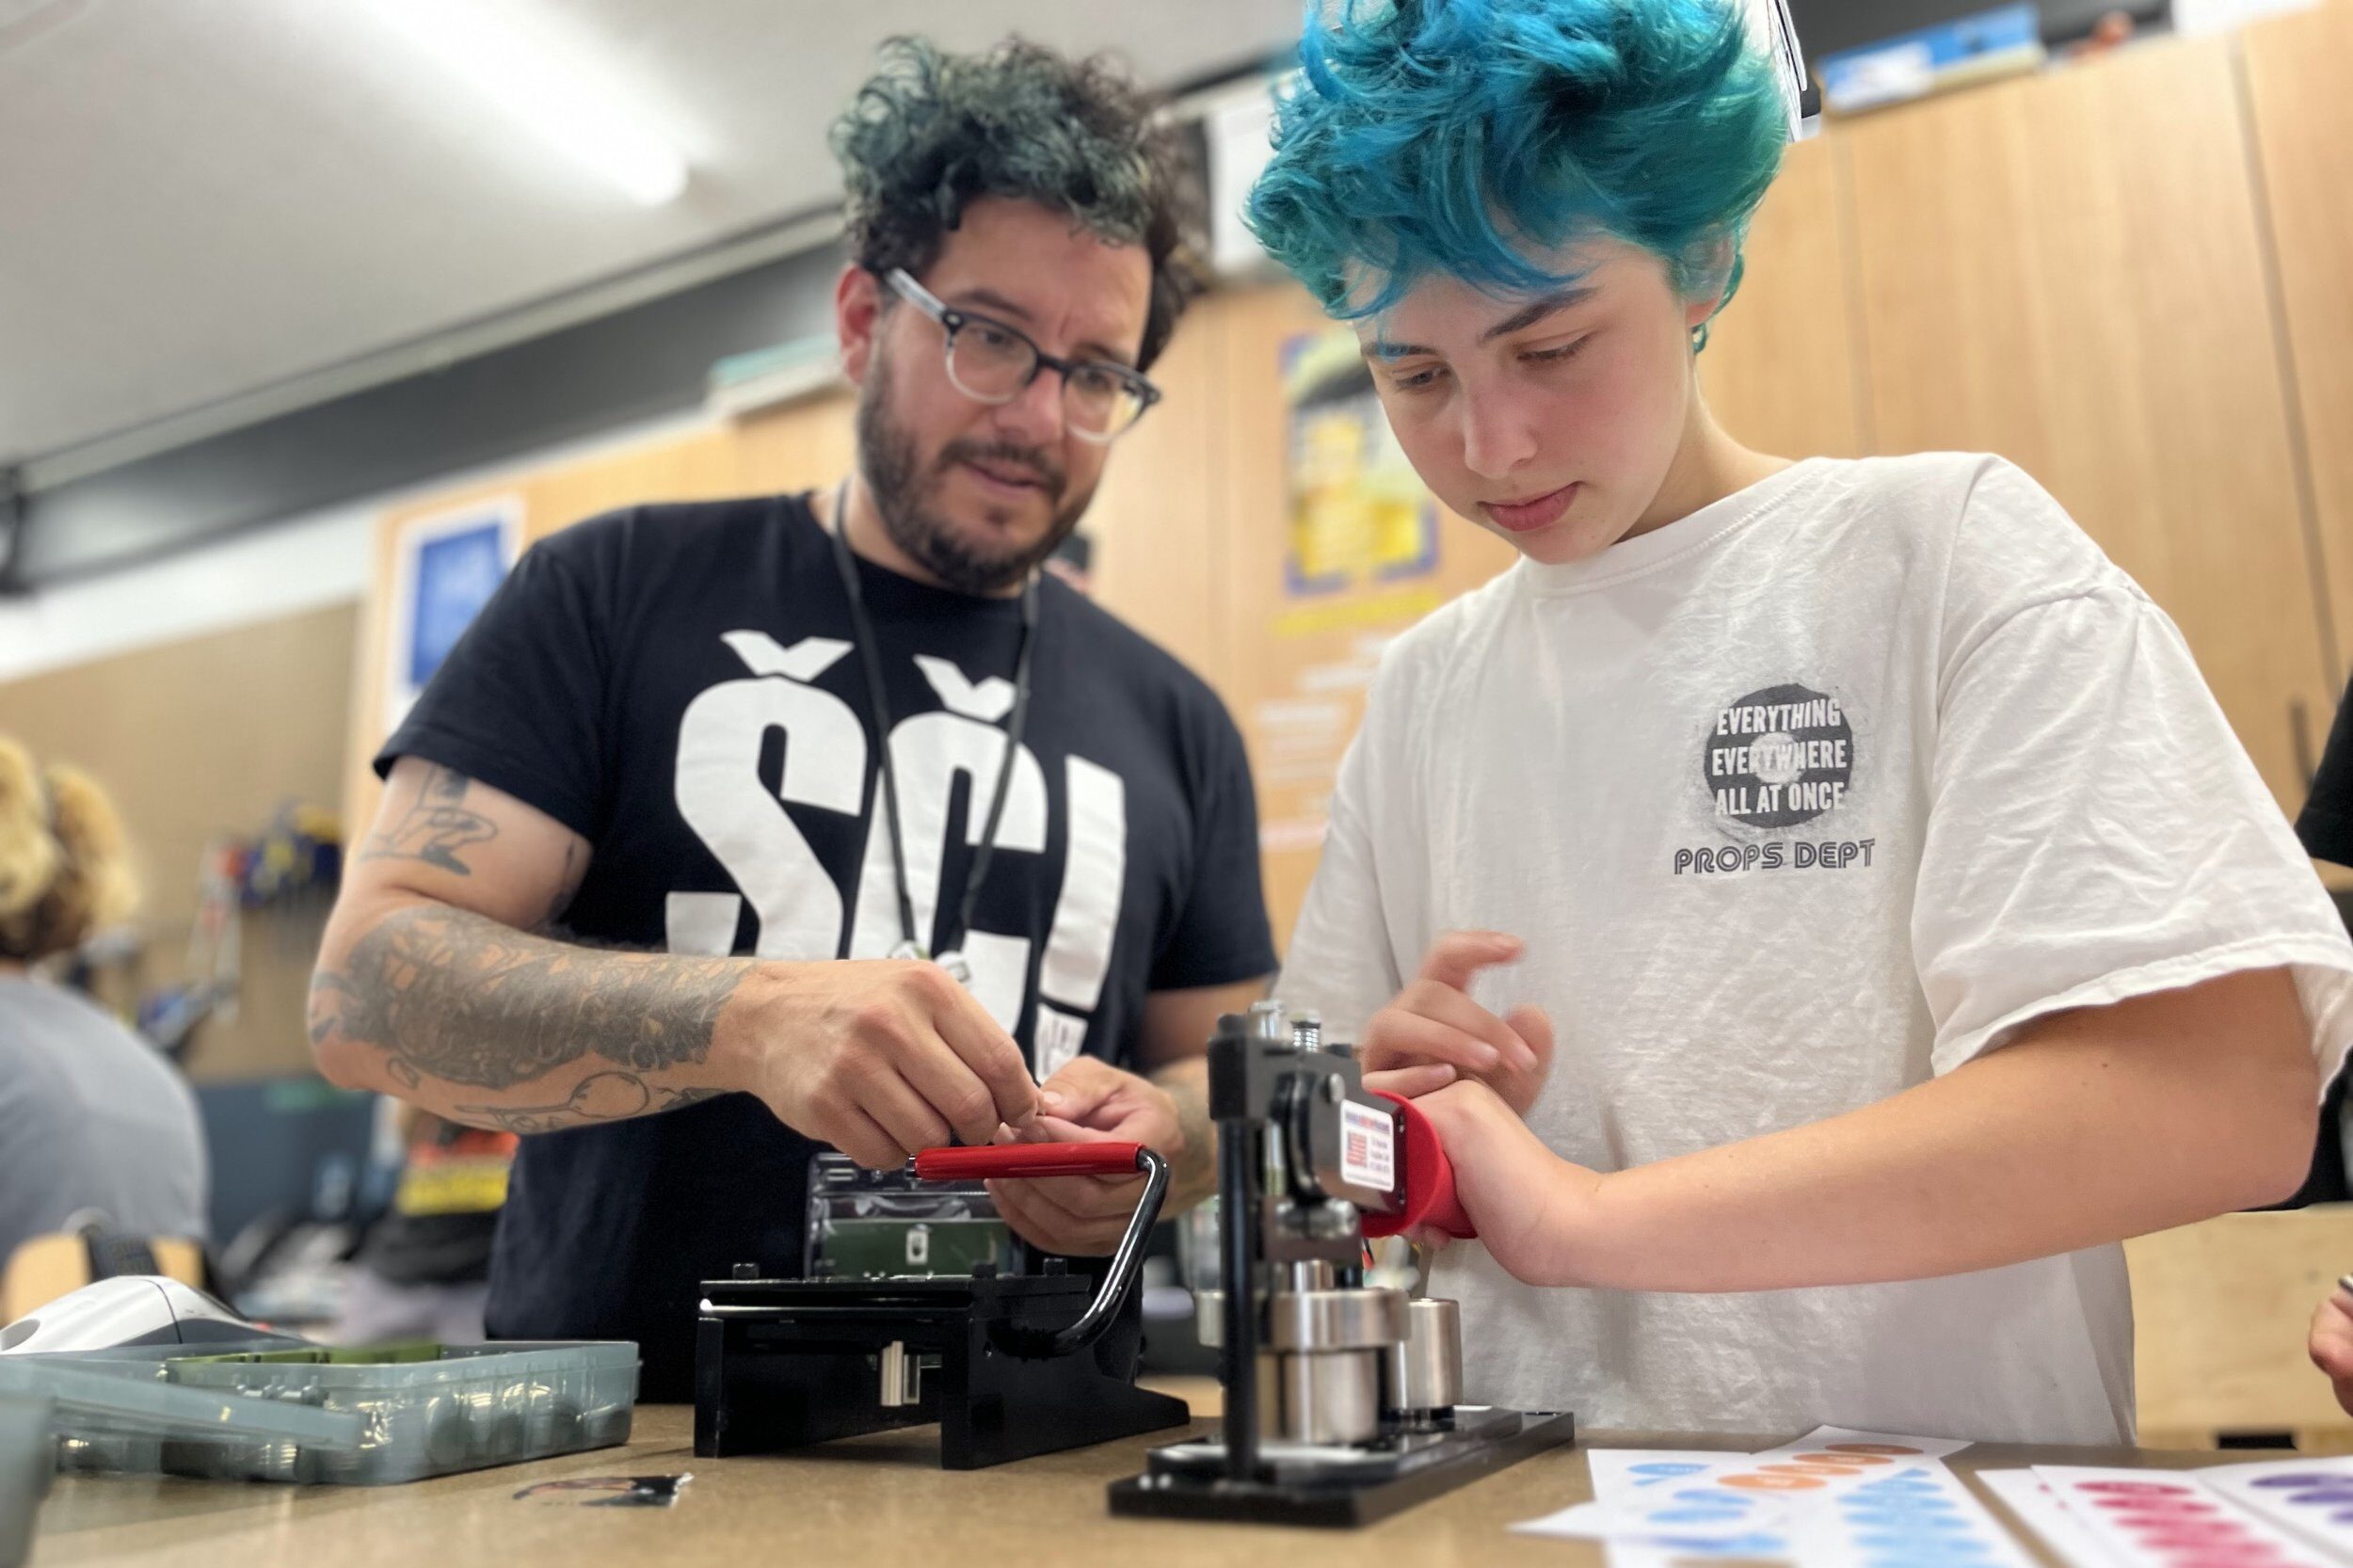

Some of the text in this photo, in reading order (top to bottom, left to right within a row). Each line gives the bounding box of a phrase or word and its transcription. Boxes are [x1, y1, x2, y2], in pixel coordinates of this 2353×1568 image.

[1716, 697, 1841, 736] EVERYTHING
[1711, 739, 1848, 776] EVERYWHERE
[1715, 781, 1845, 816] ALL AT ONCE
[1673, 838, 1876, 875] PROPS DEPT
